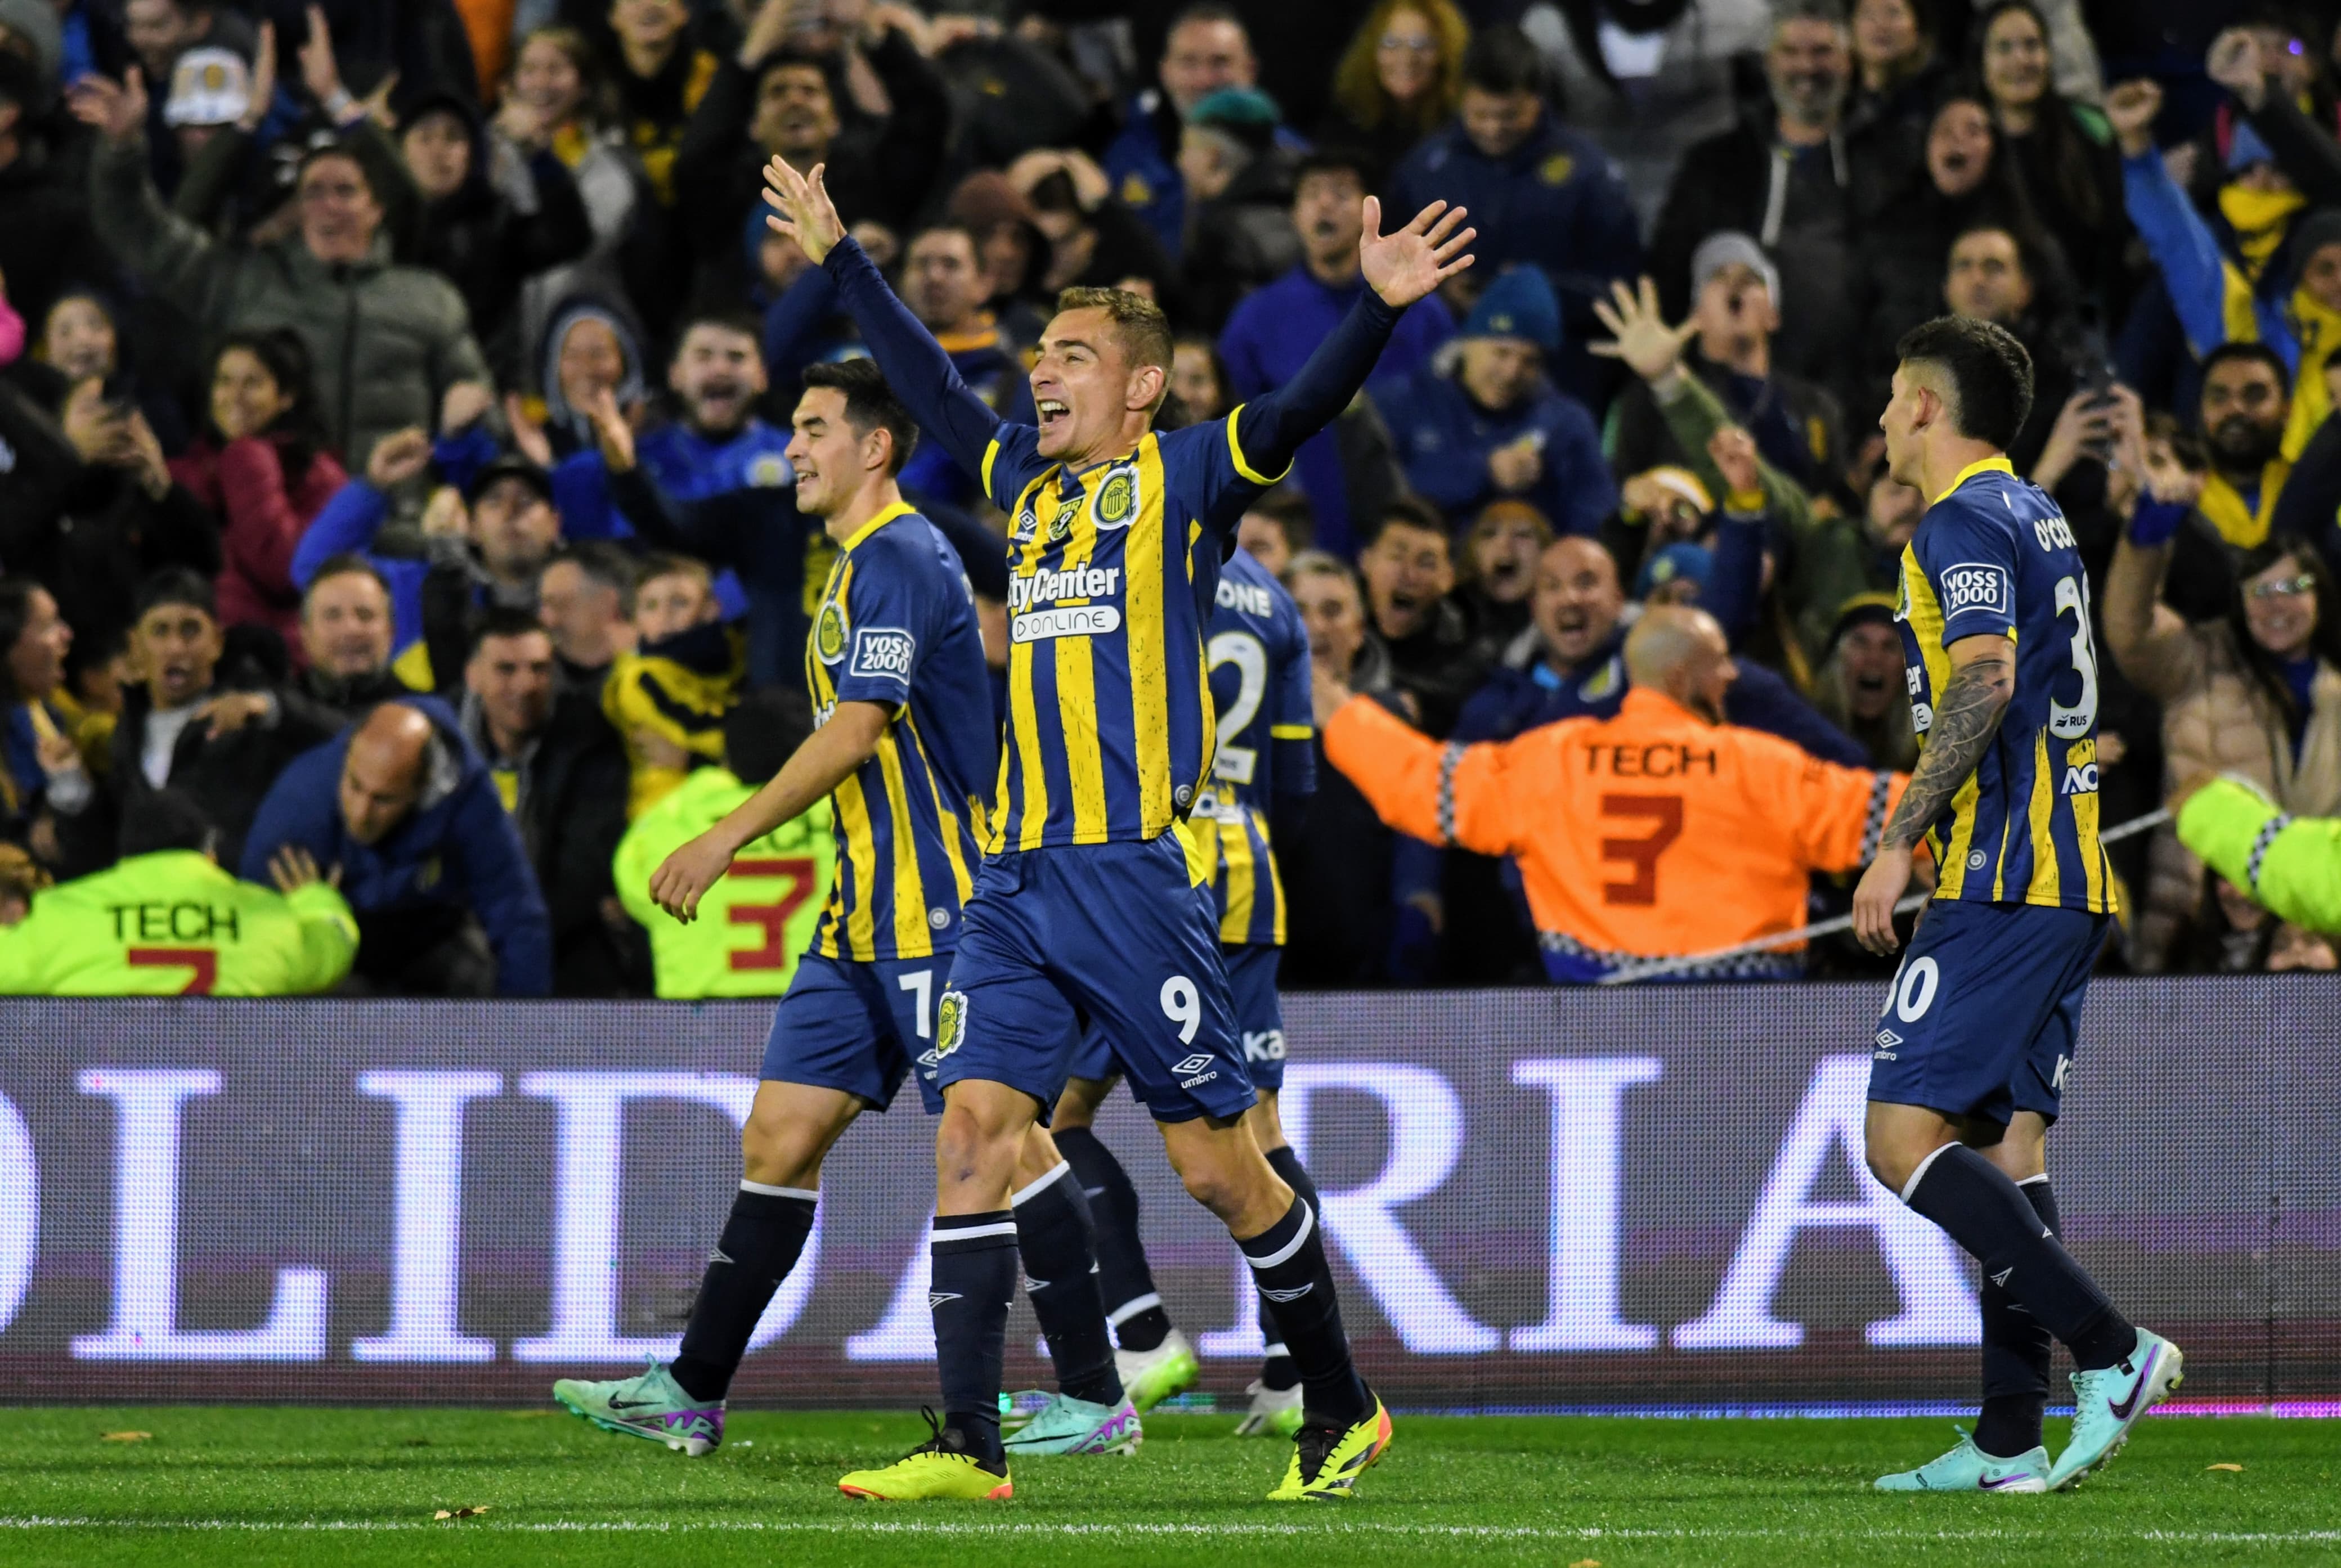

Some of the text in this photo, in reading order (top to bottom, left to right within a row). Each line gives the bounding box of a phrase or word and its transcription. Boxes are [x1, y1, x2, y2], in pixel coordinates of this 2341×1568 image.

[1948, 570, 1998, 592] VOSS
[1214, 577, 1272, 618] ONE
[1950, 587, 1998, 611] 2000
[1031, 610, 1106, 635] ONLINE
[865, 636, 911, 659] VOSS
[2051, 575, 2098, 740] 3
[861, 653, 908, 675] 2000
[2070, 715, 2088, 727] RUS
[1580, 743, 1716, 779] TECH
[102, 900, 240, 941] TECH
[897, 970, 932, 1039] 7
[1160, 975, 1201, 1045] 9
[1181, 1071, 1217, 1089] umbro
